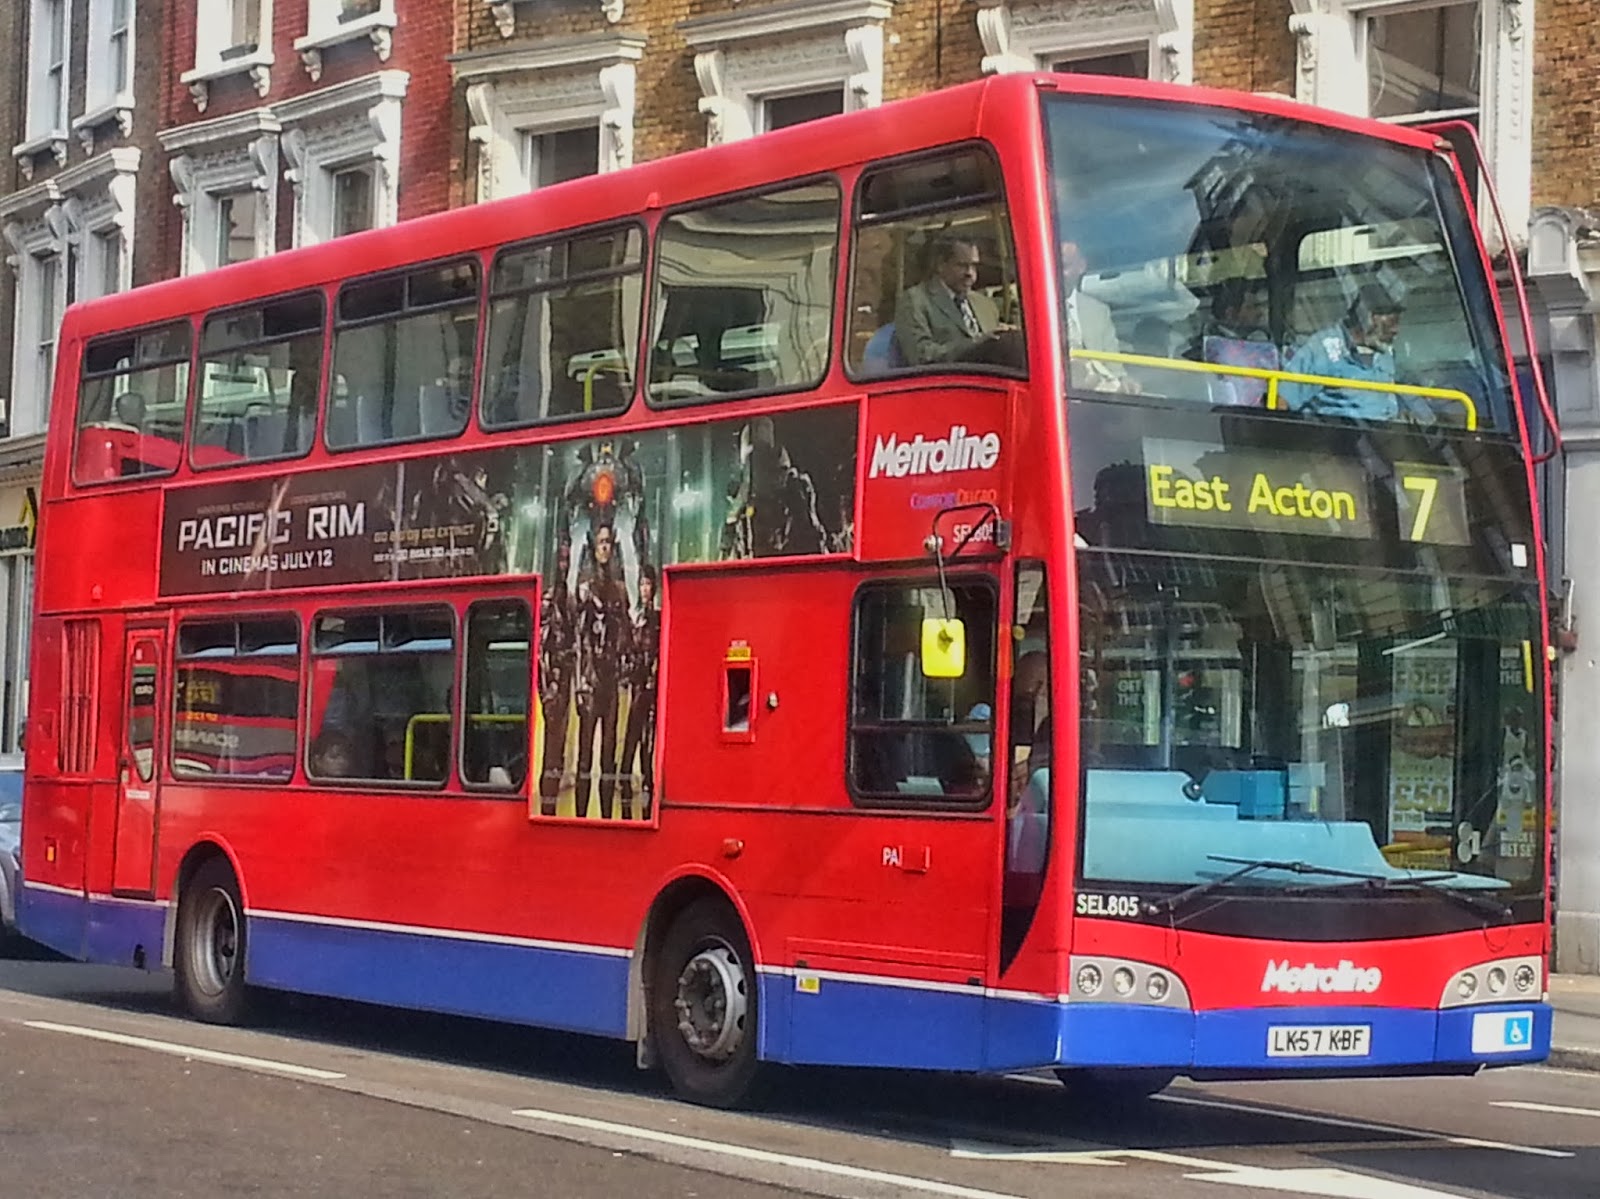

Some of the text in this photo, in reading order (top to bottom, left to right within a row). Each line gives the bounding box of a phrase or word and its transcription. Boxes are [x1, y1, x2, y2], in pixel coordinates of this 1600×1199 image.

[869, 425, 1000, 479] Metroline
[1151, 464, 1356, 521] East Acton
[1403, 476, 1438, 541] 7
[178, 502, 366, 551] PACIFIC RIM
[201, 549, 333, 576] IN CINEMAS JULY 12
[881, 847, 899, 867] PA
[1076, 893, 1140, 917] SEL805
[1260, 959, 1383, 993] Metroline
[1274, 1029, 1364, 1051] LK57 KBF
